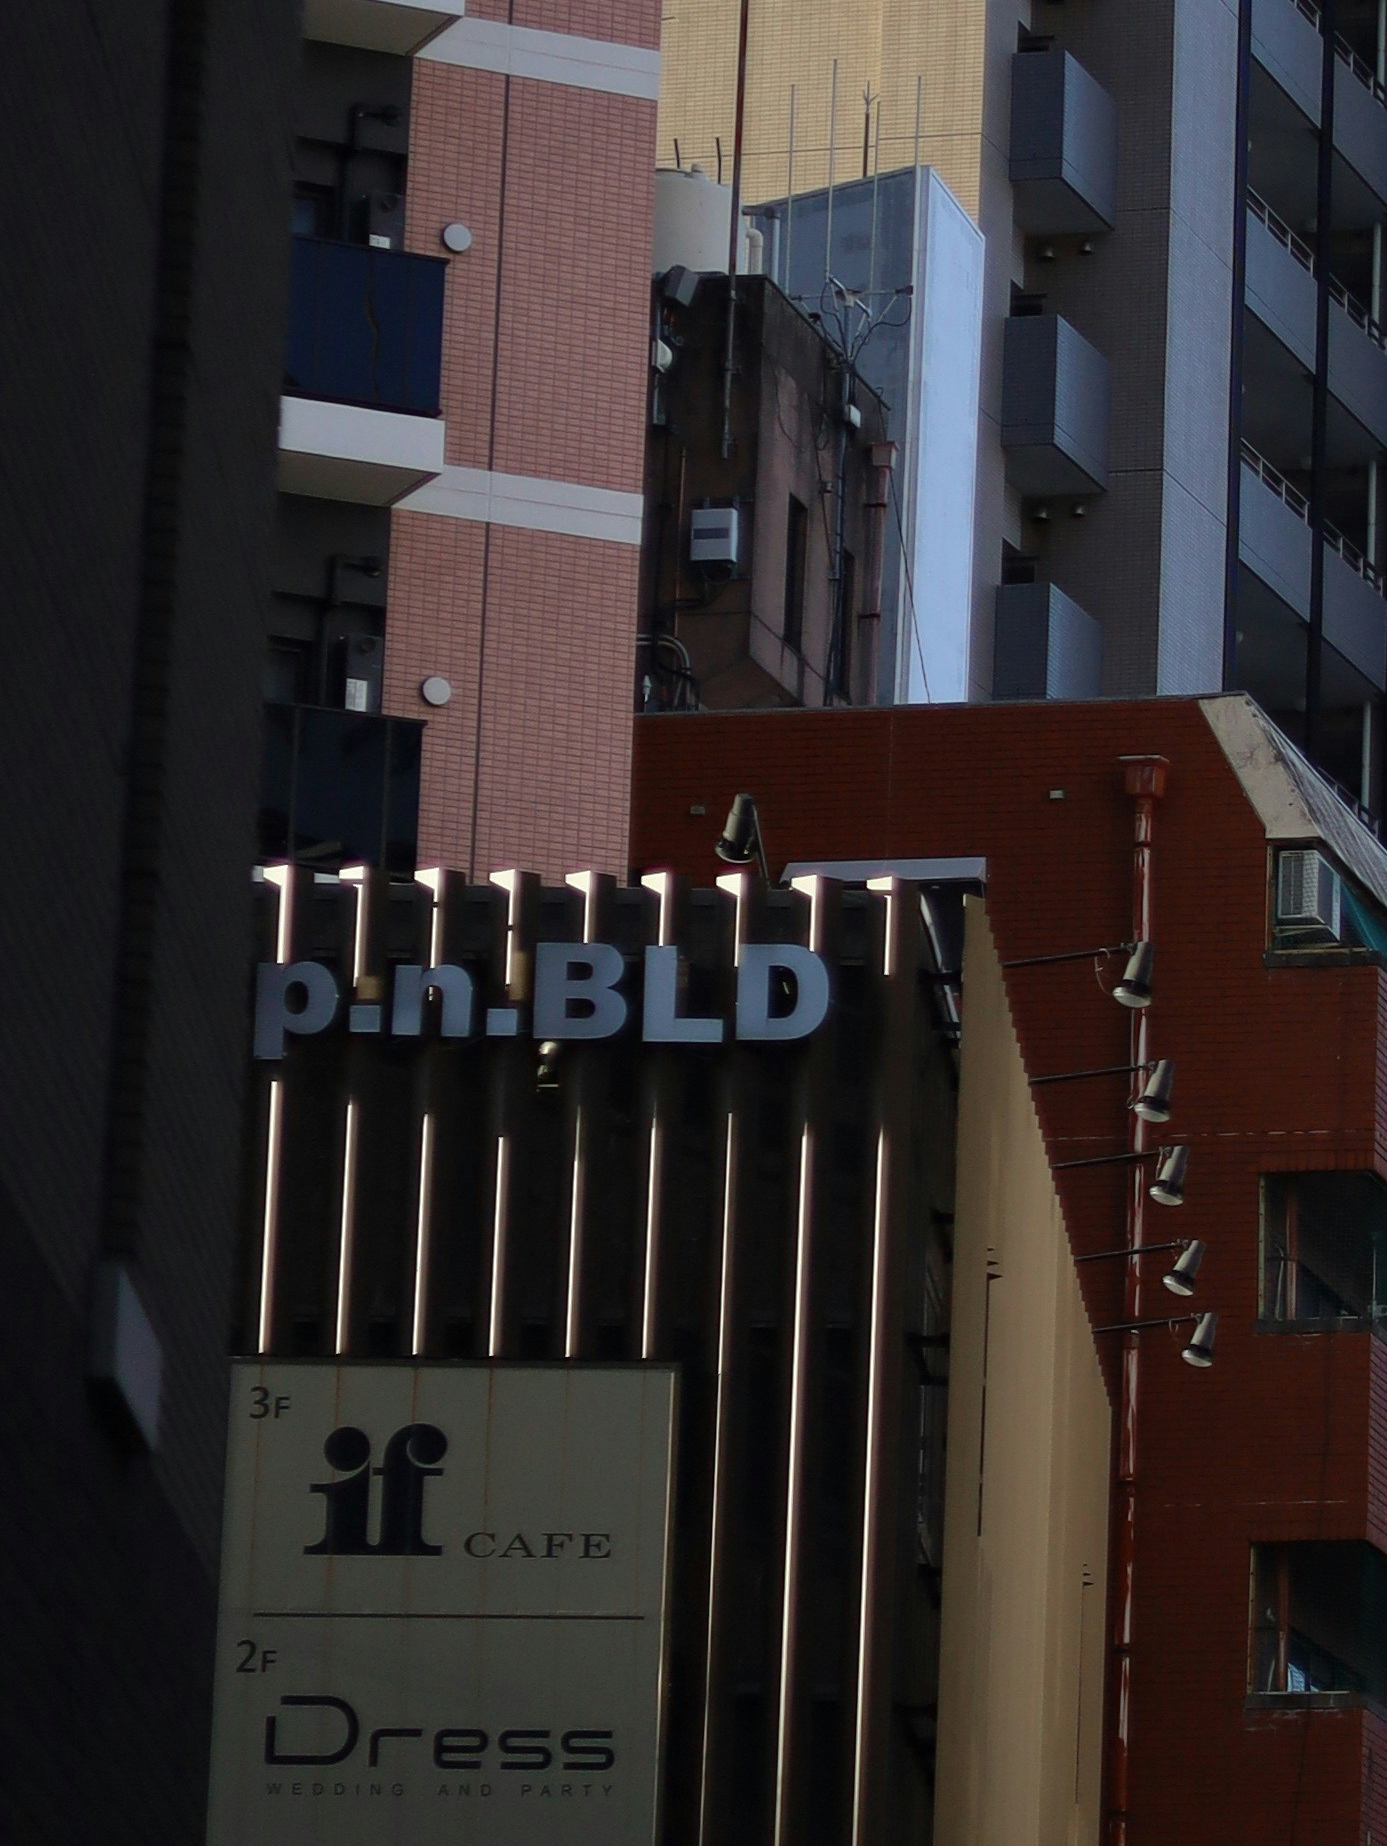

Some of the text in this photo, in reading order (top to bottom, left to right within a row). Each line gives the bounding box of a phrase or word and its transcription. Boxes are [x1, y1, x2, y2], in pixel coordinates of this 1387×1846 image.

[249, 1387, 290, 1419] 3F
[304, 1423, 613, 1559] if CAFE
[236, 1640, 277, 1673] 2F
[265, 1696, 615, 1770] Dress
[266, 1783, 615, 1798] WEDDING AND PARTY
